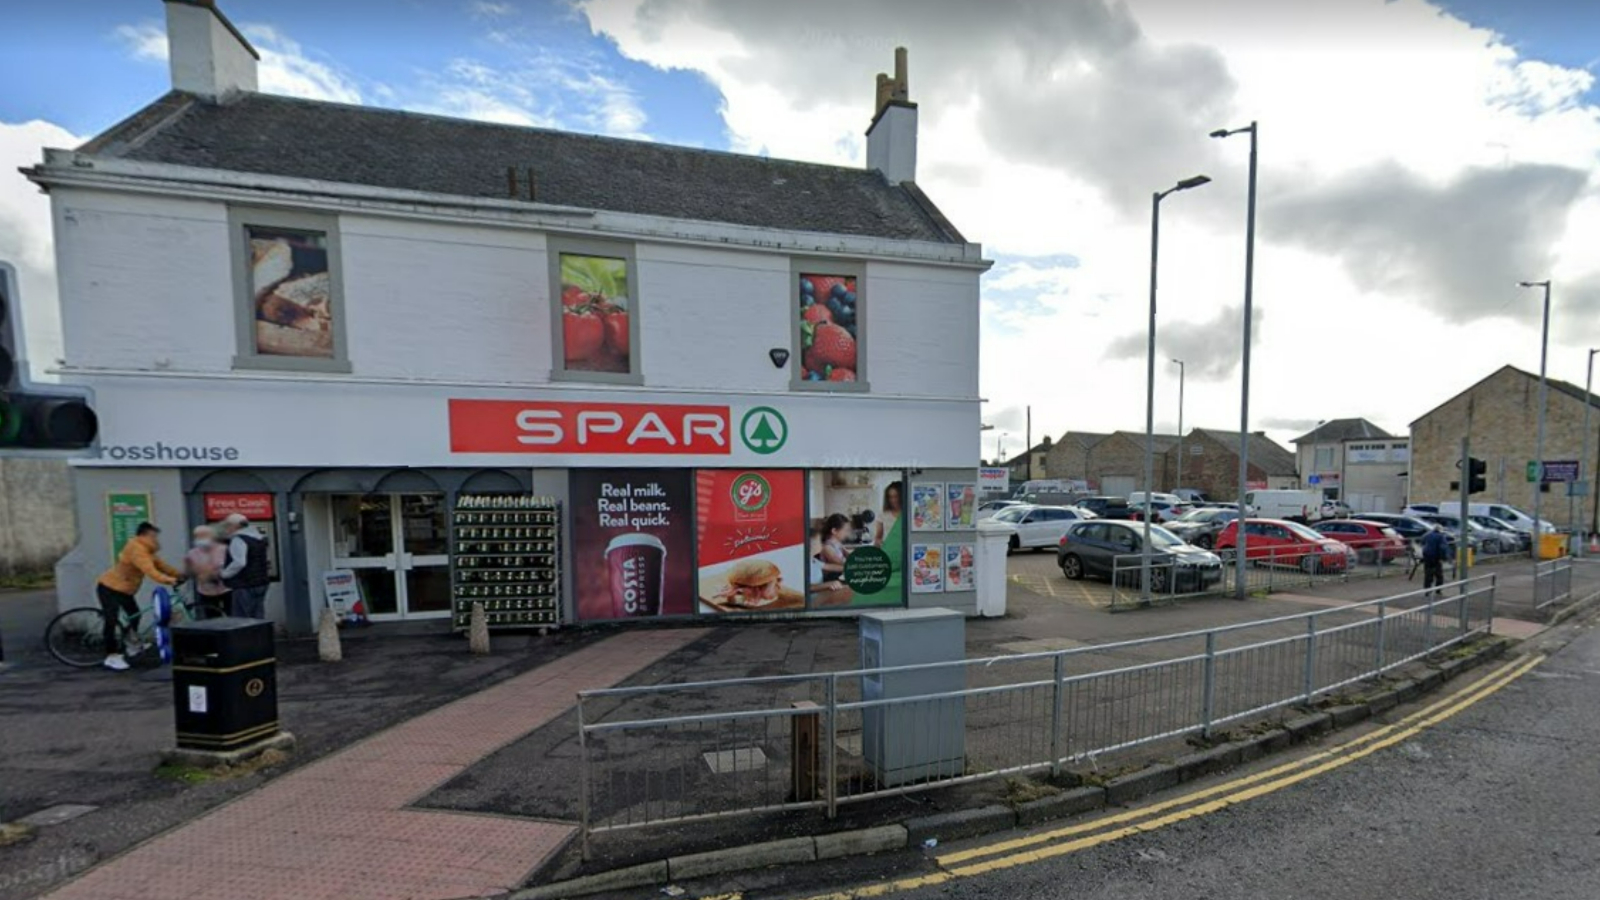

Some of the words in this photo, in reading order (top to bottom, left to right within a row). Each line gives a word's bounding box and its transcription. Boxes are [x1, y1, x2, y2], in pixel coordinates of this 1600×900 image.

[515, 409, 725, 446] SPAR
[98, 441, 239, 461] rosshouse
[601, 483, 630, 497] Real
[633, 483, 666, 497] milk.
[208, 498, 235, 507] Free
[598, 499, 627, 512] Real
[630, 499, 670, 512] beans.
[599, 513, 629, 527] Real
[631, 513, 670, 531] quick.
[623, 557, 637, 613] COSTA
